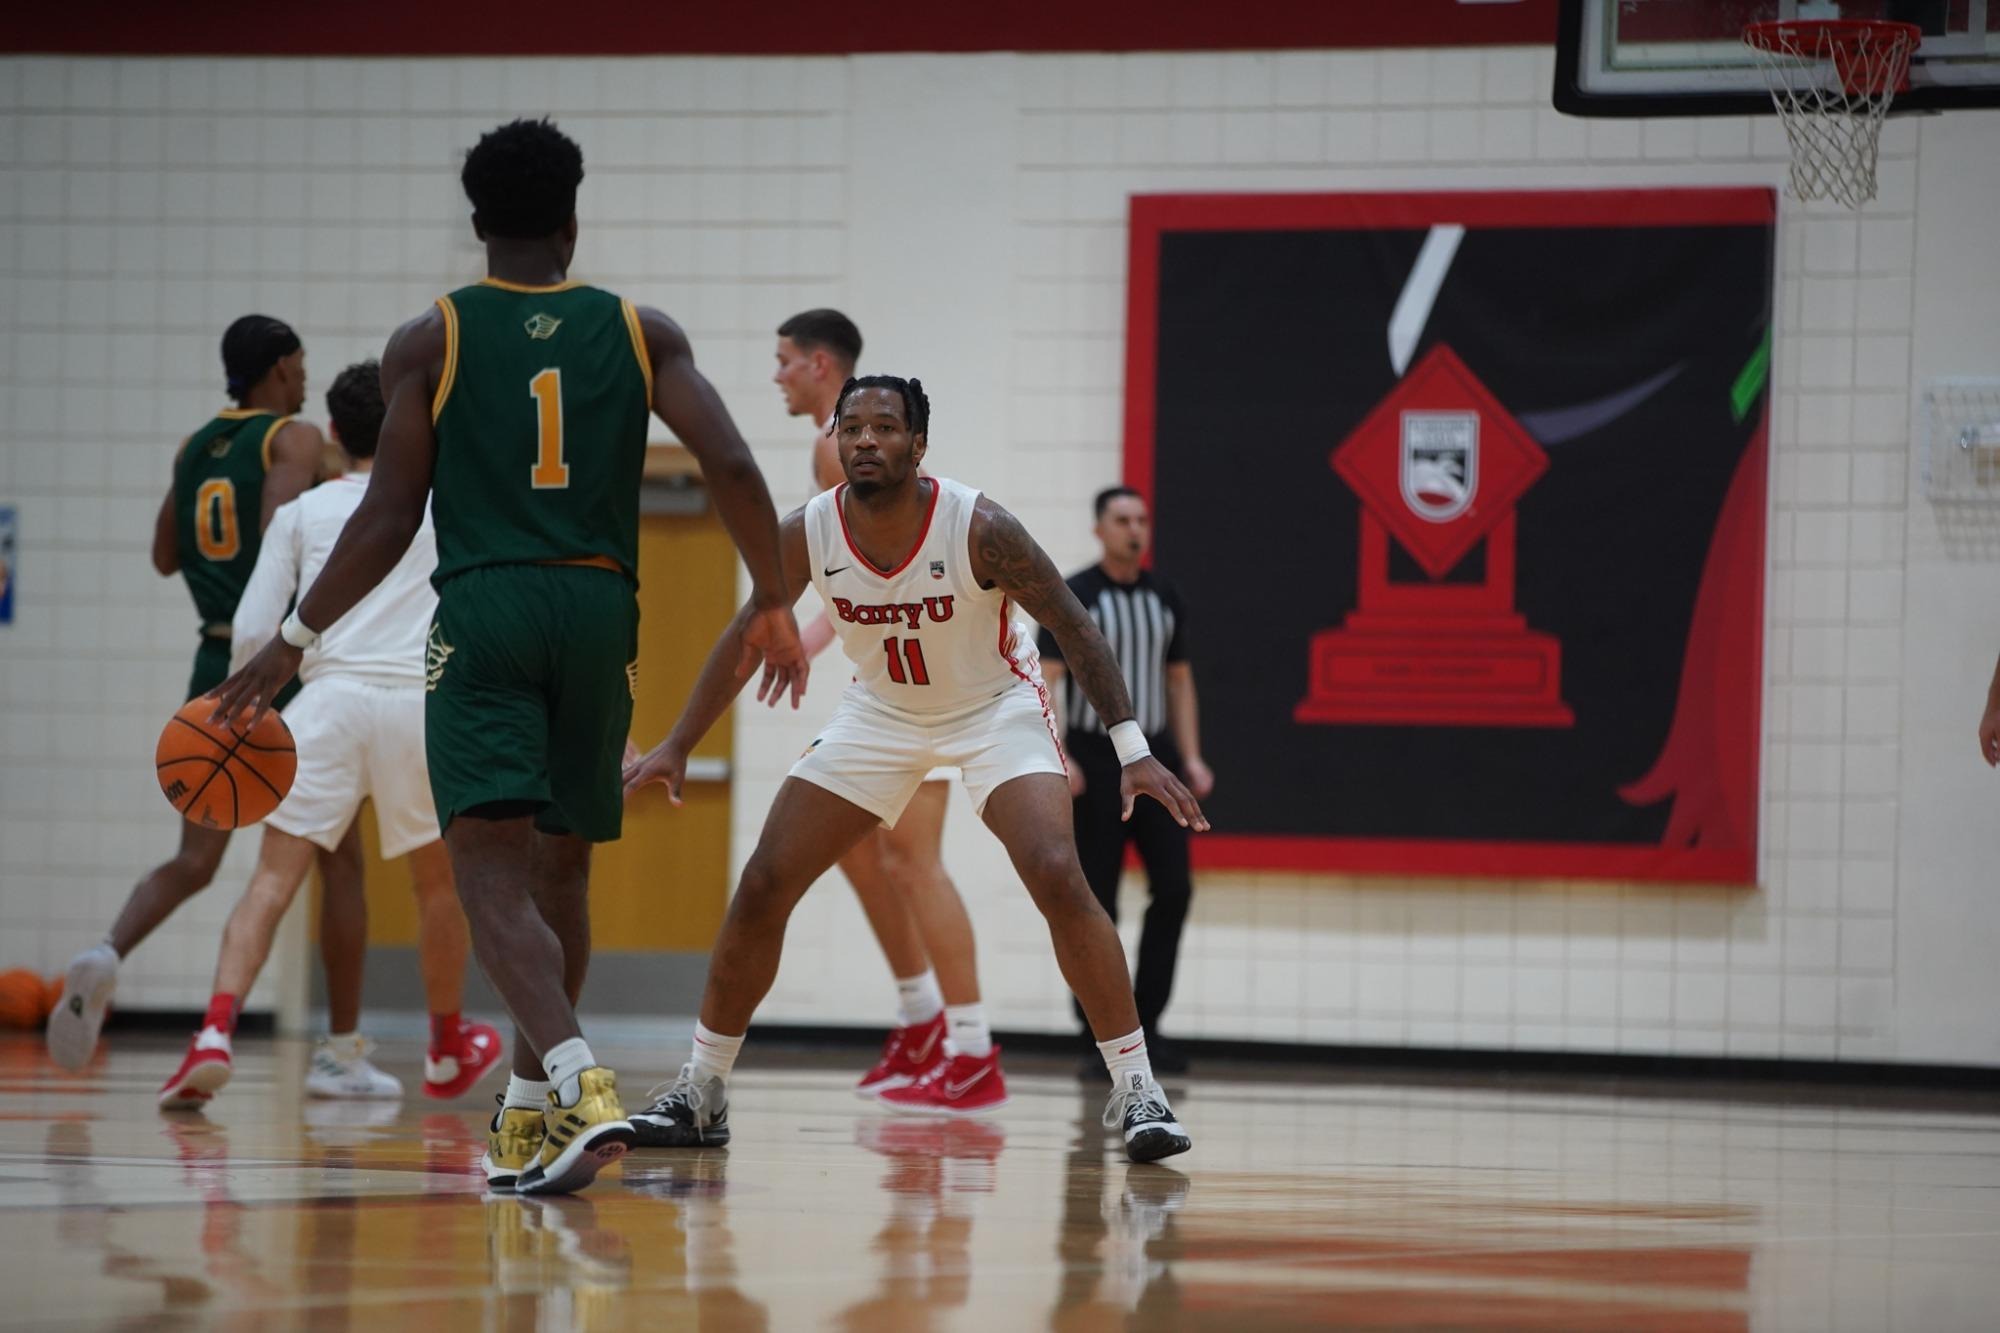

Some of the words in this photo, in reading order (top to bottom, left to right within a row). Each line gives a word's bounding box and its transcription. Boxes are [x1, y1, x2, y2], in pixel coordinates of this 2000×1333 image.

[529, 367, 569, 489] 1
[195, 477, 240, 561] 0
[883, 636, 931, 685] 11
